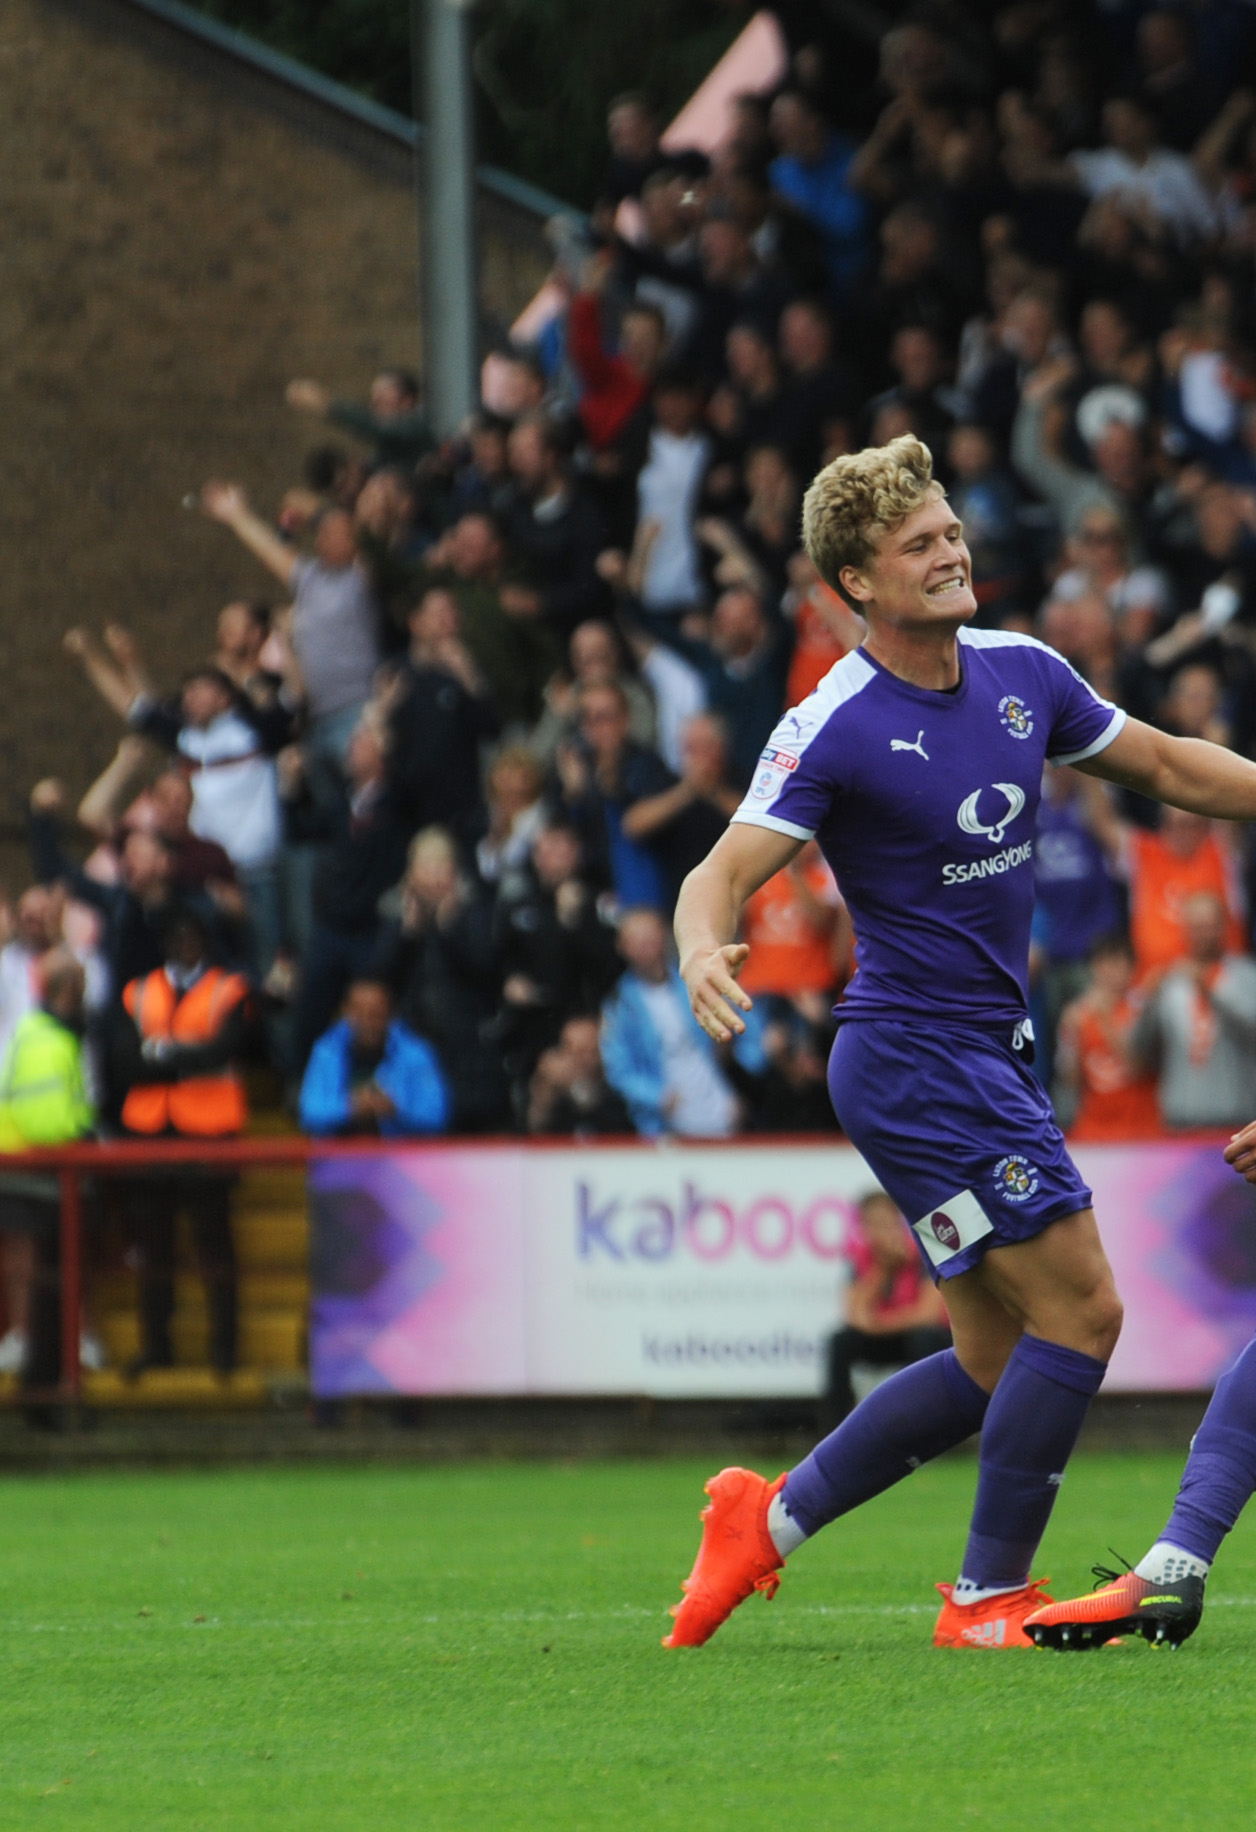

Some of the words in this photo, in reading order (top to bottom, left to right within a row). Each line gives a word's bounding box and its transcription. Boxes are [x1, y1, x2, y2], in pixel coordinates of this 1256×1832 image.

[774, 753, 797, 769] BET
[942, 840, 1031, 885] SSANGYONG
[576, 1179, 858, 1262] kaboo
[643, 1331, 824, 1367] kaboodle
